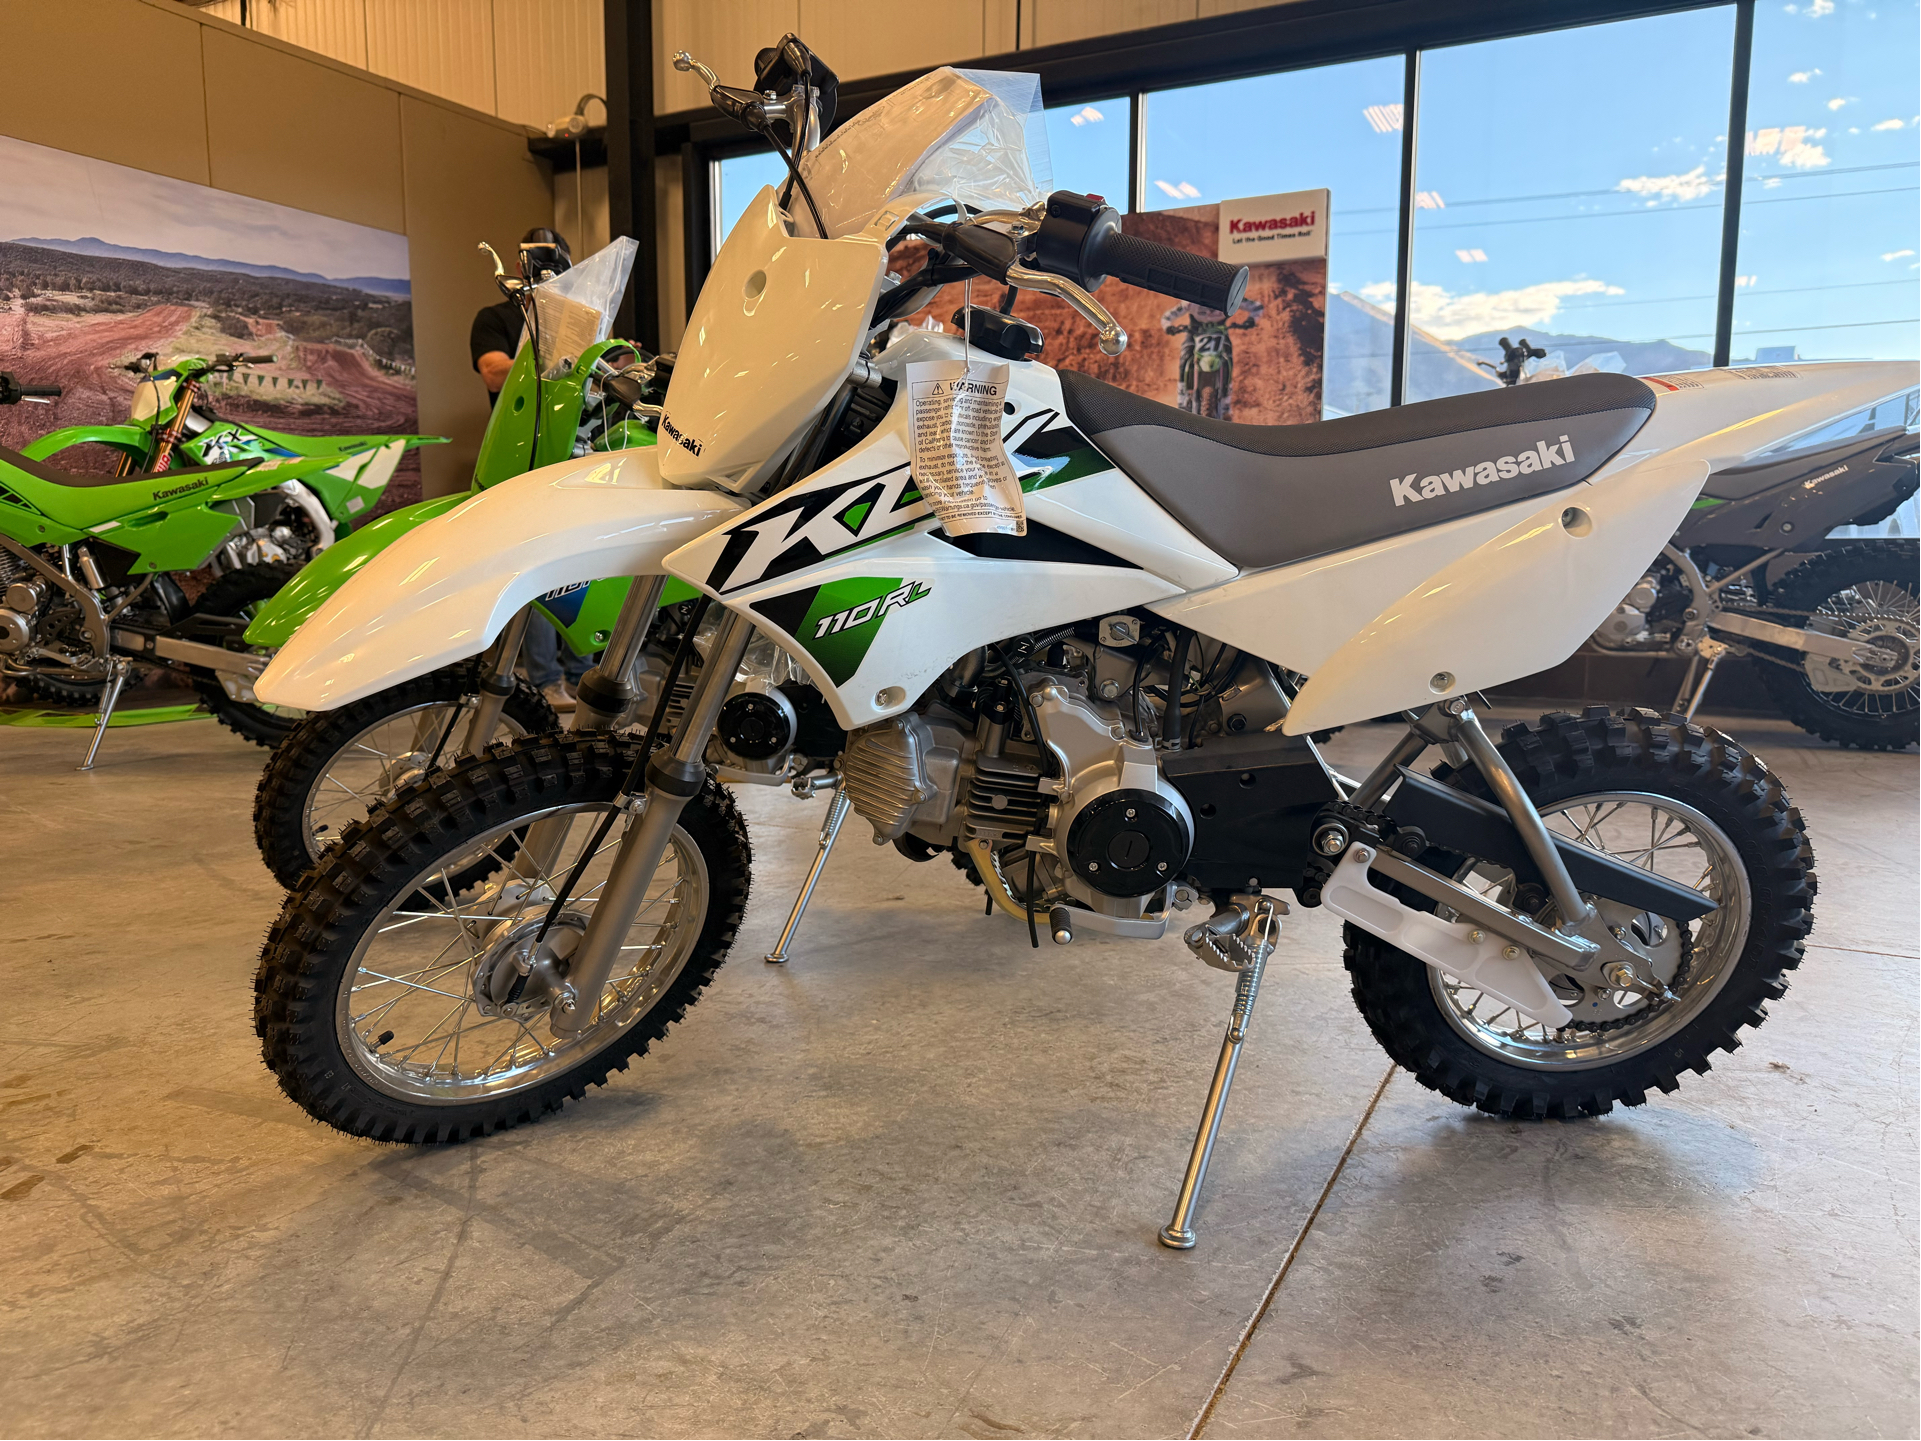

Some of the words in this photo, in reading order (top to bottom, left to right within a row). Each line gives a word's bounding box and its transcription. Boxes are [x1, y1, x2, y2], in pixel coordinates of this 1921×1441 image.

[1229, 210, 1315, 234] Kawasaki
[1199, 336, 1222, 353] 21
[950, 382, 997, 396] WARNING
[916, 407, 942, 415] passenger
[662, 414, 702, 457] Kawasaki
[927, 454, 946, 462] minimize
[1389, 434, 1576, 507] Kawasaki
[1802, 464, 1848, 488] Kawasaki
[152, 476, 209, 501] Kawasaki
[812, 580, 932, 640] 110RL
